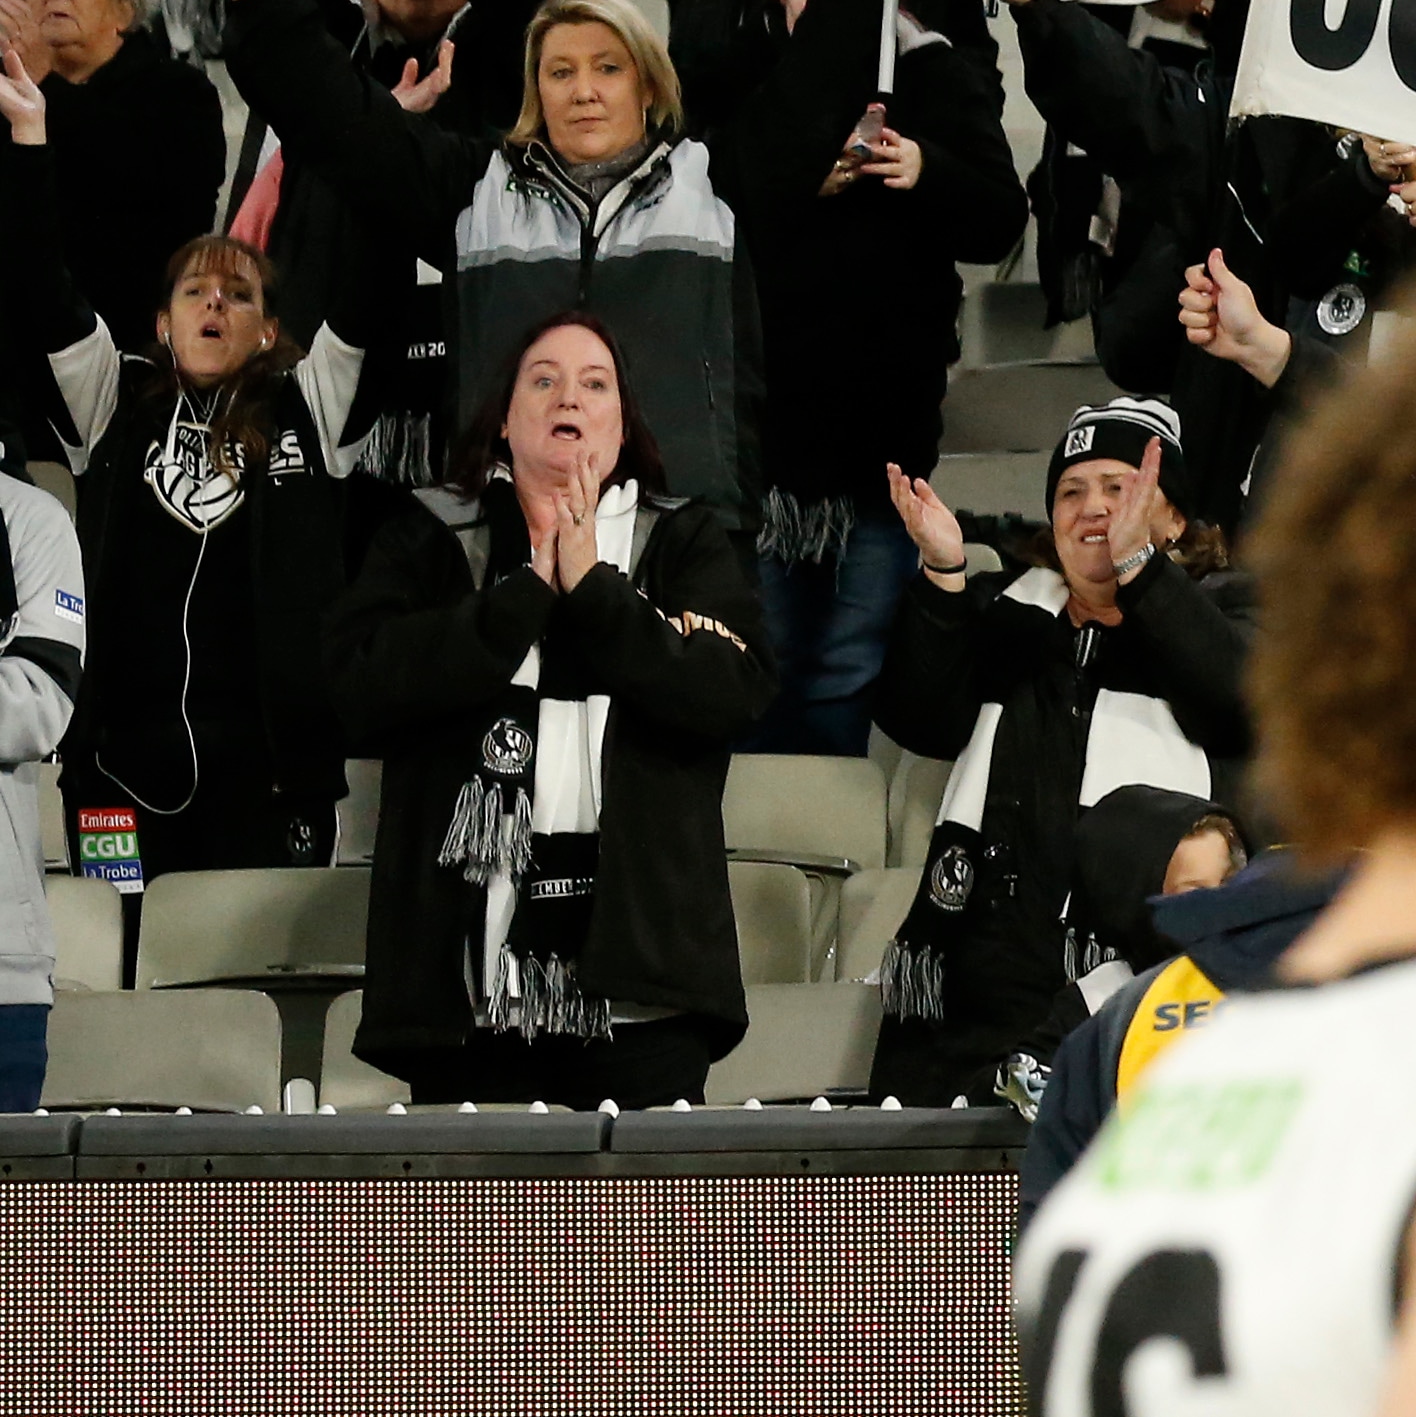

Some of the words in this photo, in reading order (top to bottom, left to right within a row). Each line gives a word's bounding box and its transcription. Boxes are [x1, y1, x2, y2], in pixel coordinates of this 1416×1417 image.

[81, 811, 134, 829] Emirates
[82, 834, 136, 858] CGU
[98, 864, 139, 879] Trobe
